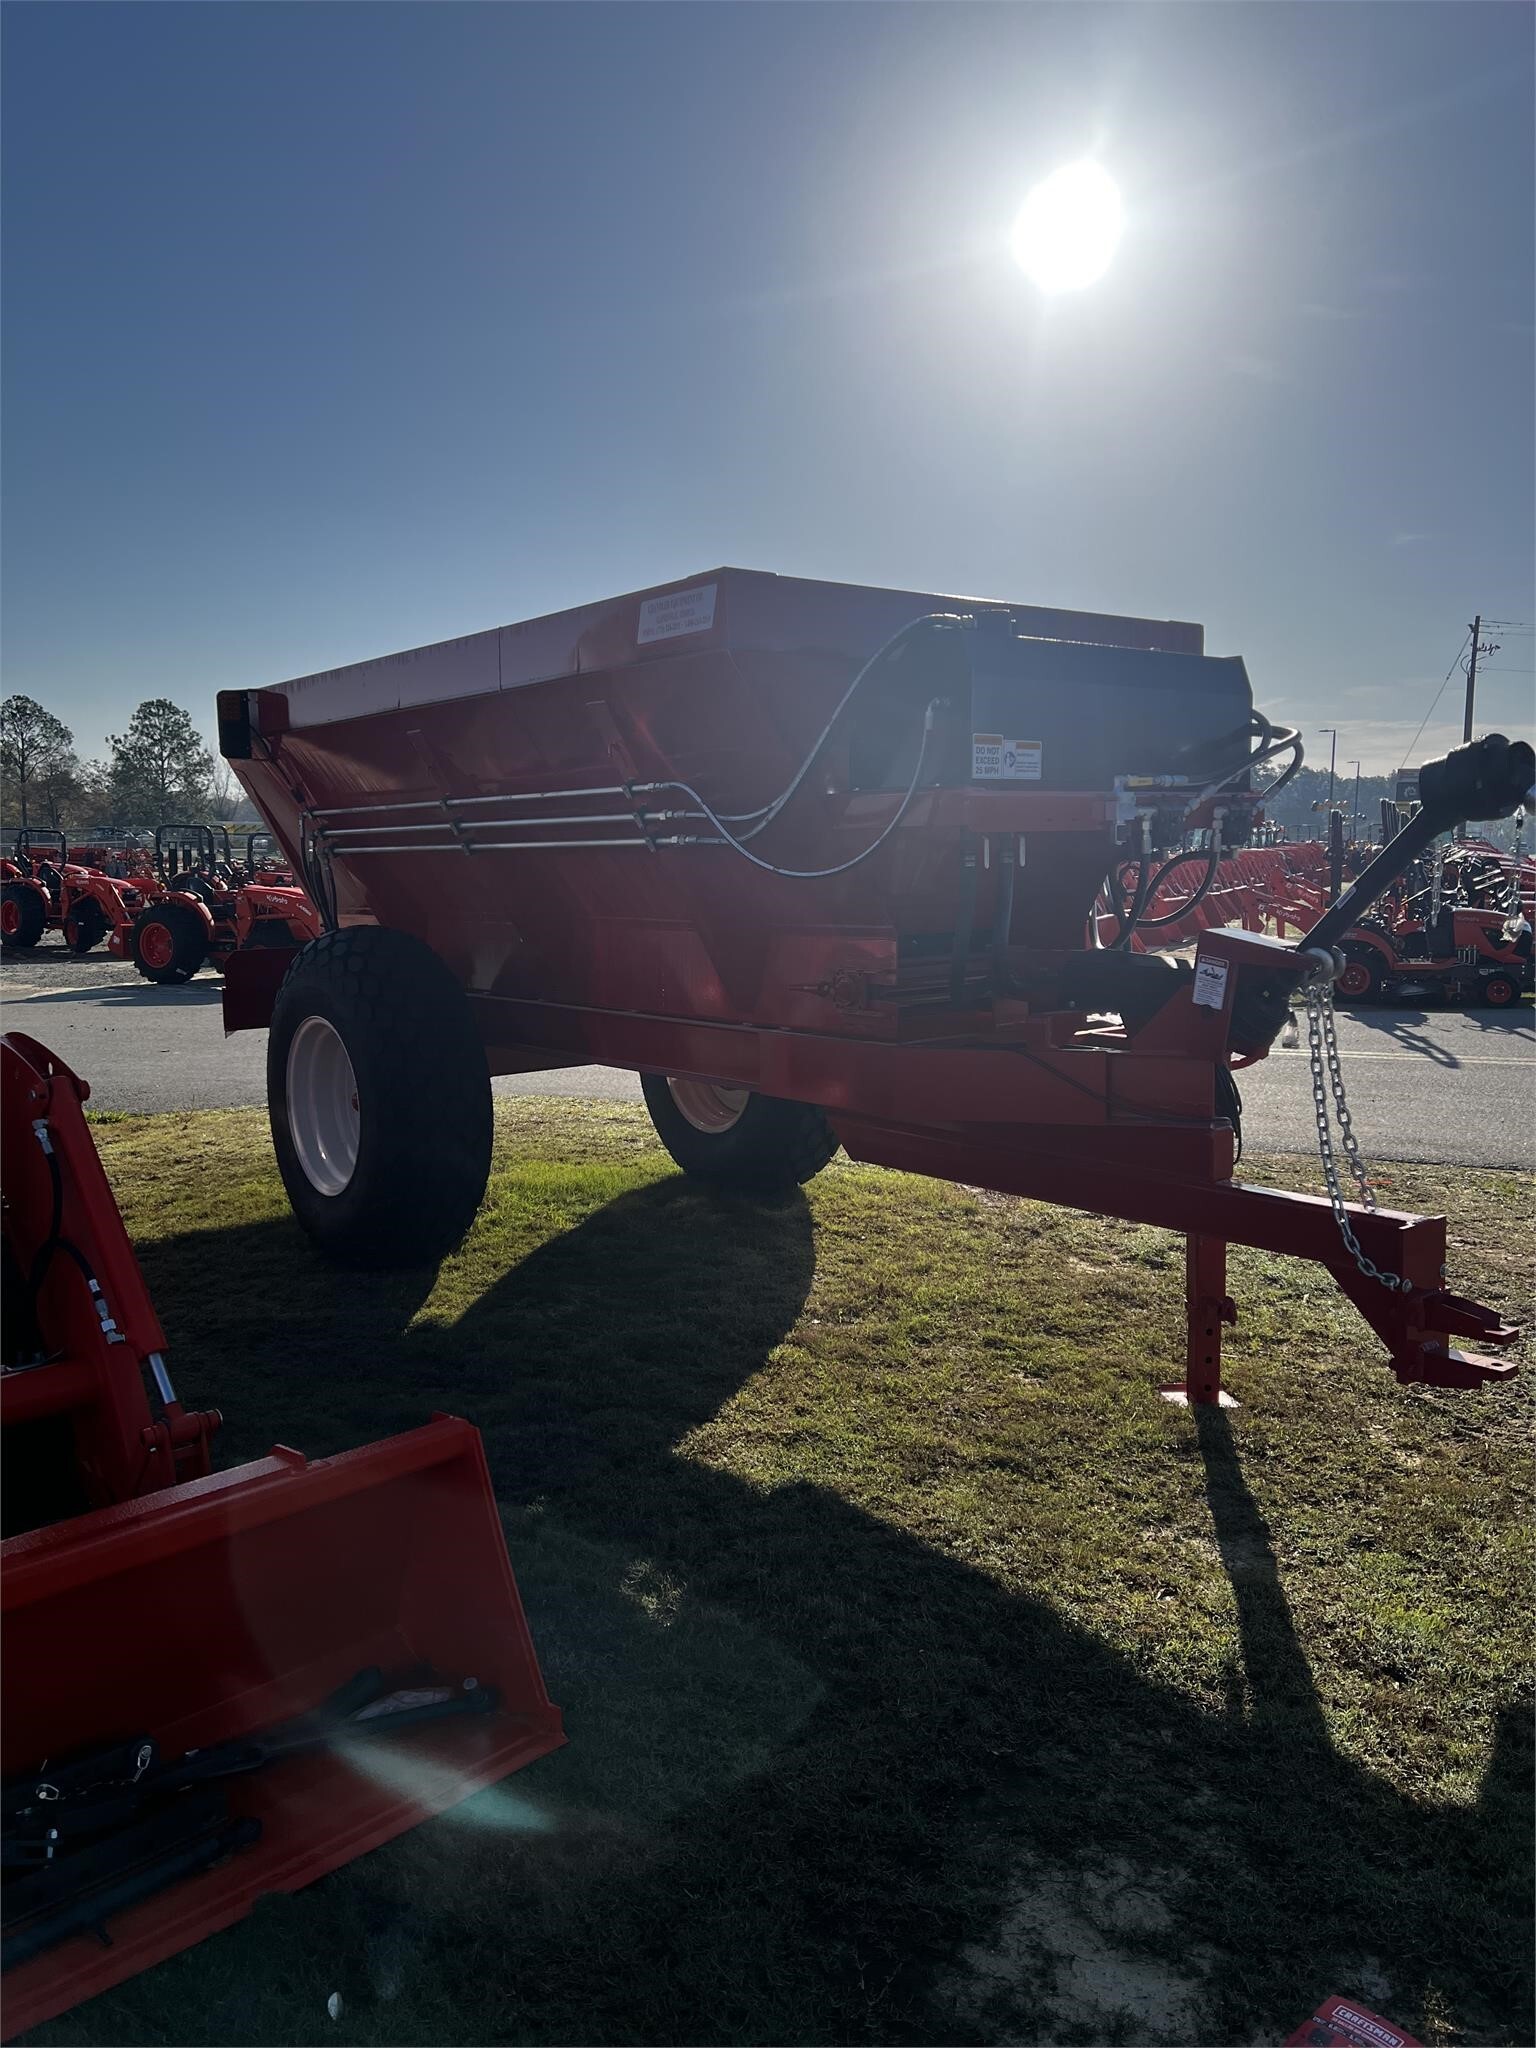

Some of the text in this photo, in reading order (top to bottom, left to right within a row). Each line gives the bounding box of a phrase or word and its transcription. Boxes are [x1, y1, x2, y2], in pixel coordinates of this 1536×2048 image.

[975, 746, 1000, 755] DO NOT
[975, 756, 1000, 765] EXCEED
[975, 766, 999, 775] 25 MPH
[266, 894, 288, 905] Kubota
[1338, 2008, 1398, 2046] CRAFTSMAN
